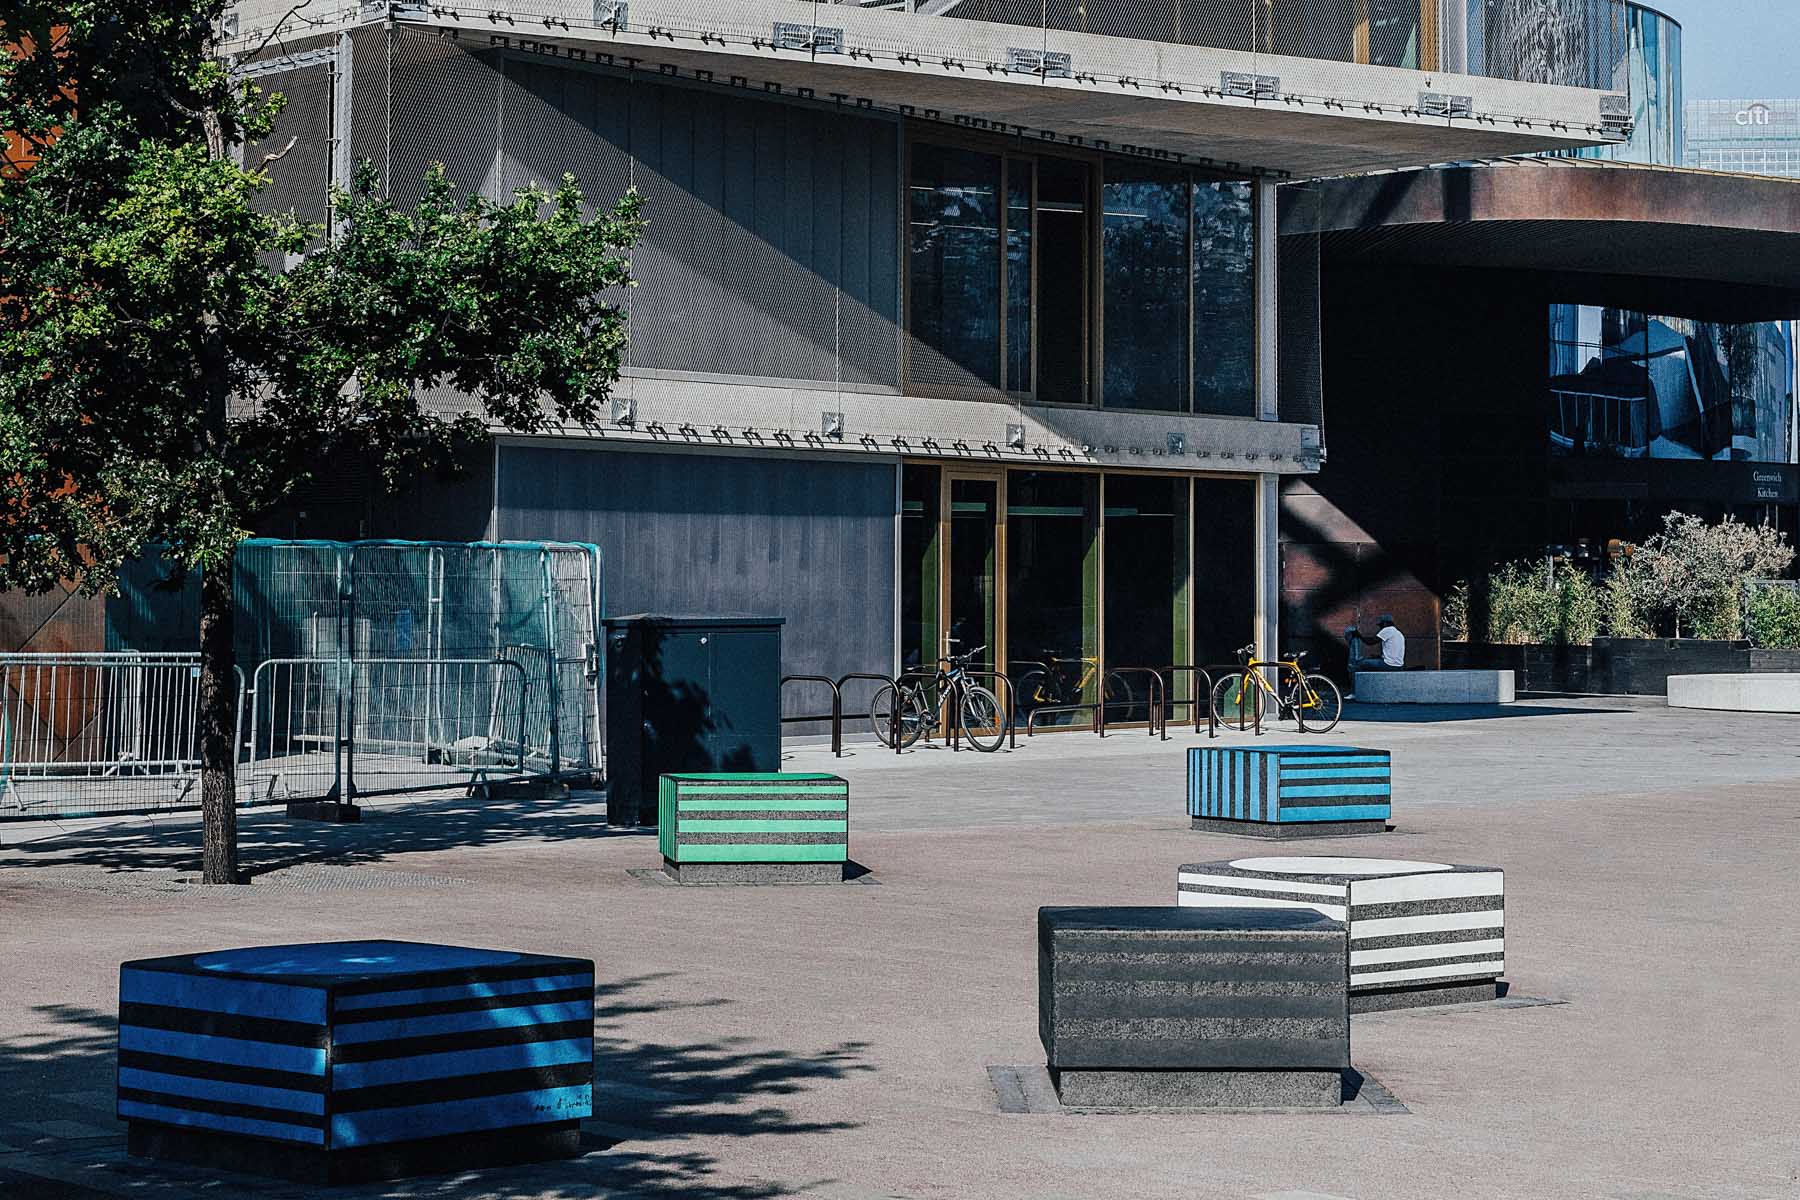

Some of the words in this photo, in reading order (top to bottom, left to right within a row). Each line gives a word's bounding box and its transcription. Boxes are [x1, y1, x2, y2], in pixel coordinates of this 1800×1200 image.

[1735, 104, 1769, 126] citi
[1753, 470, 1782, 482] Greenwich
[1757, 487, 1778, 498] Kitchen
